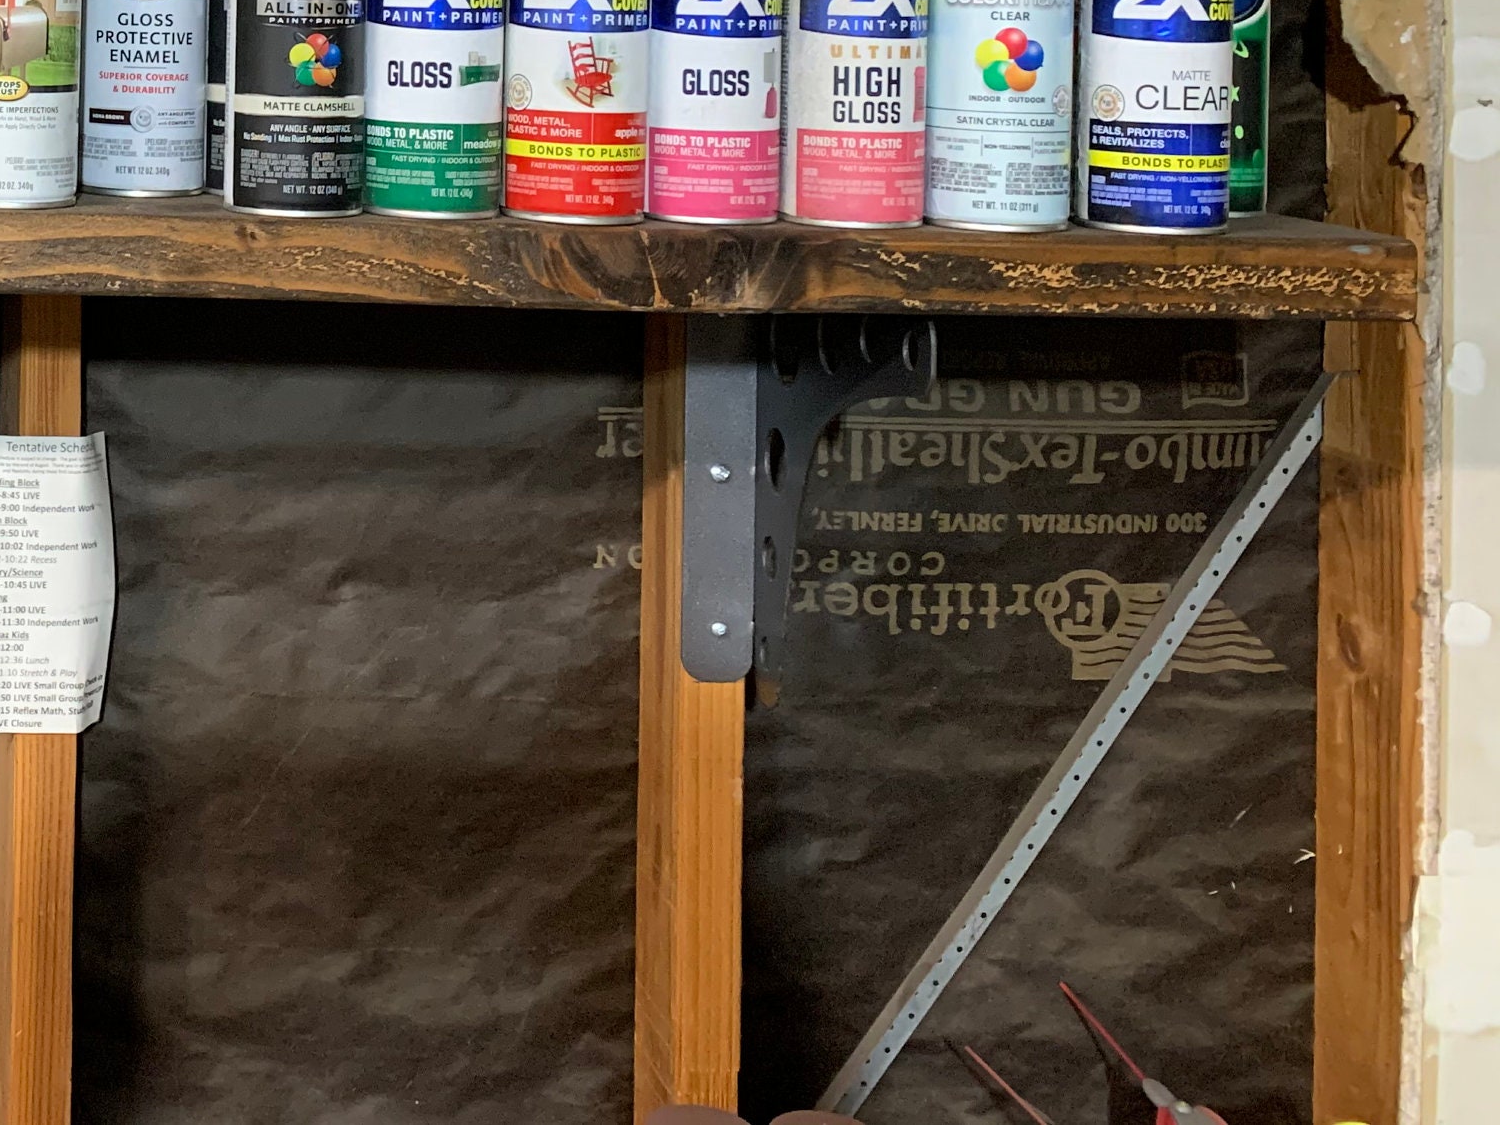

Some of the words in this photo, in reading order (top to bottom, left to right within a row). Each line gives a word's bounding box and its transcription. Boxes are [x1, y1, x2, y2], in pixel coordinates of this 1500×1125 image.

[117, 13, 173, 26] GLOSS
[991, 11, 1030, 21] CLEAR
[96, 31, 193, 45] PROTECTIVE
[110, 49, 179, 63] ENAMEL
[99, 72, 143, 81] SUPERIOR
[146, 73, 189, 82] COVERAGE
[388, 60, 452, 88] GLOSS
[1172, 70, 1211, 81] MATTE
[683, 69, 749, 95] GLOSS
[833, 66, 901, 97] HIGH
[122, 85, 175, 94] DURABILITY
[1135, 85, 1228, 111] CLEAR
[264, 101, 300, 112] MATTE
[303, 102, 355, 112] CLAMSHELL
[833, 101, 901, 124] GLOSS
[957, 116, 983, 124] SATIN
[986, 117, 1028, 126] CRYSTAL
[409, 129, 454, 140] PLASTIC
[550, 128, 583, 137] MORE
[1092, 125, 1124, 136] SEALS,
[1127, 128, 1189, 139] PROTECTS,
[423, 141, 448, 150] MORE
[655, 134, 686, 146] BONDS
[707, 136, 750, 147] PLASTIC
[860, 137, 902, 149] PLASTIC
[1100, 137, 1165, 149] REVITALIZES
[529, 145, 572, 157] BONDS
[601, 147, 641, 157] PLASTIC
[1122, 156, 1171, 168] BONDS
[1177, 159, 1194, 168] TO
[6, 442, 57, 452] Tentative
[18, 478, 40, 486] Block
[23, 505, 75, 513] Independent
[1166, 512, 1207, 534] 300
